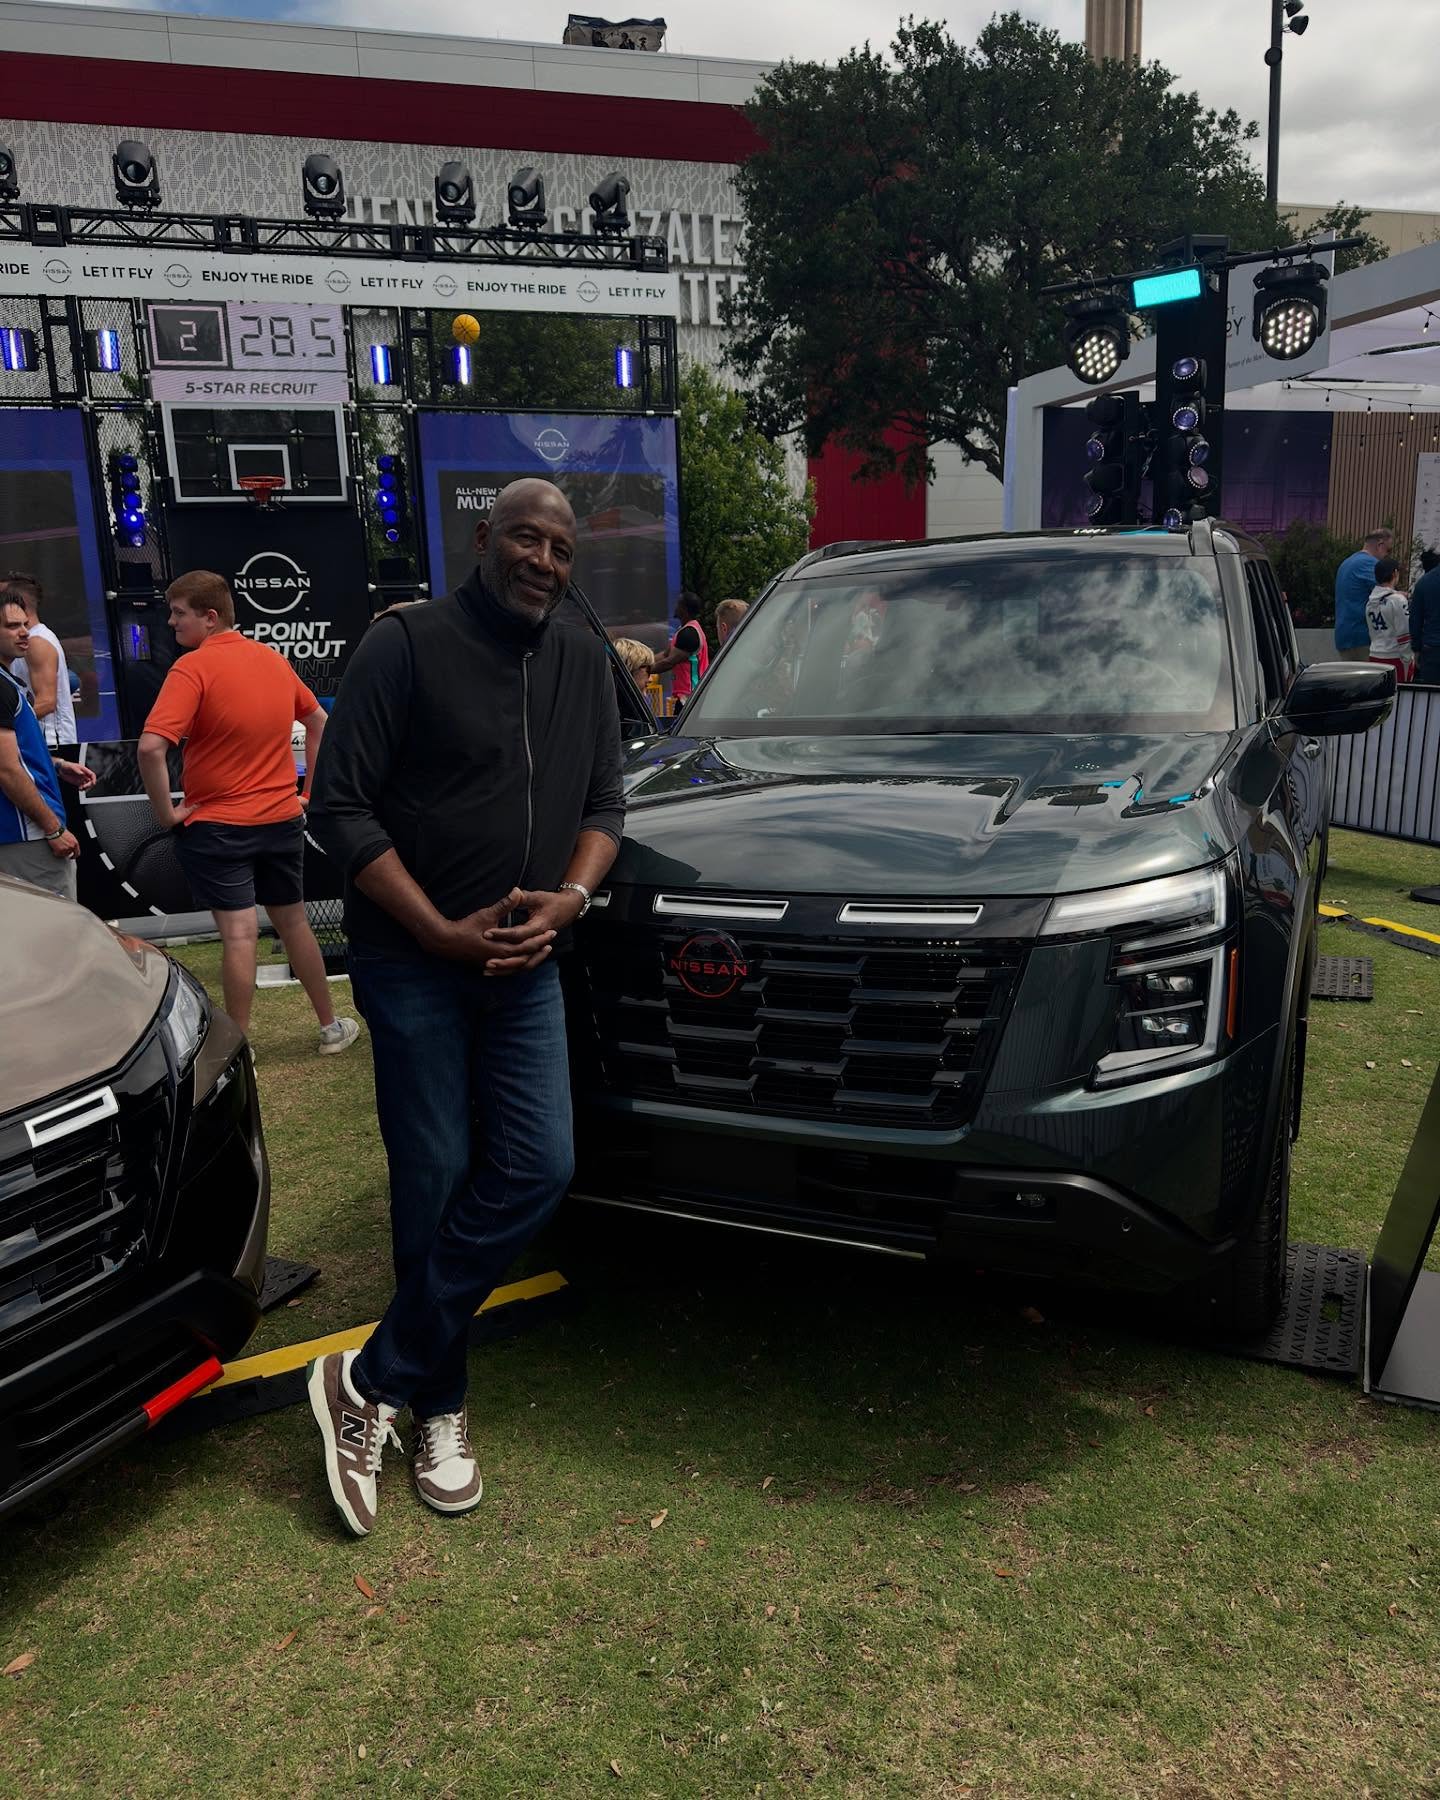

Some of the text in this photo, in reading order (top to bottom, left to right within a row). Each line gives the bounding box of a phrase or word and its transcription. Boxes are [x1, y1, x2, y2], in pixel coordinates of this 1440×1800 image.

[82, 266, 109, 278] LET
[112, 267, 125, 278] IT
[128, 268, 153, 280] FLY
[202, 271, 248, 283] ENJOY
[251, 273, 279, 284] THE
[282, 274, 314, 285] RIDE
[361, 277, 384, 288] LET
[387, 278, 398, 288] IT
[402, 279, 424, 289] FLY
[467, 282, 508, 293] ENJOY
[510, 283, 536, 293] THE
[538, 284, 567, 295] RIDE
[609, 287, 630, 297] LET
[633, 288, 643, 297] IT
[646, 289, 666, 298] FLY
[180, 315, 336, 358] 2 28.5
[185, 382, 318, 395] 5-STAR RECRUIT
[456, 487, 497, 496] ALL-NEW
[234, 576, 311, 589] NISSAN
[1368, 611, 1388, 631] 34
[233, 621, 331, 641] -POINT
[670, 958, 747, 977] NISSAN
